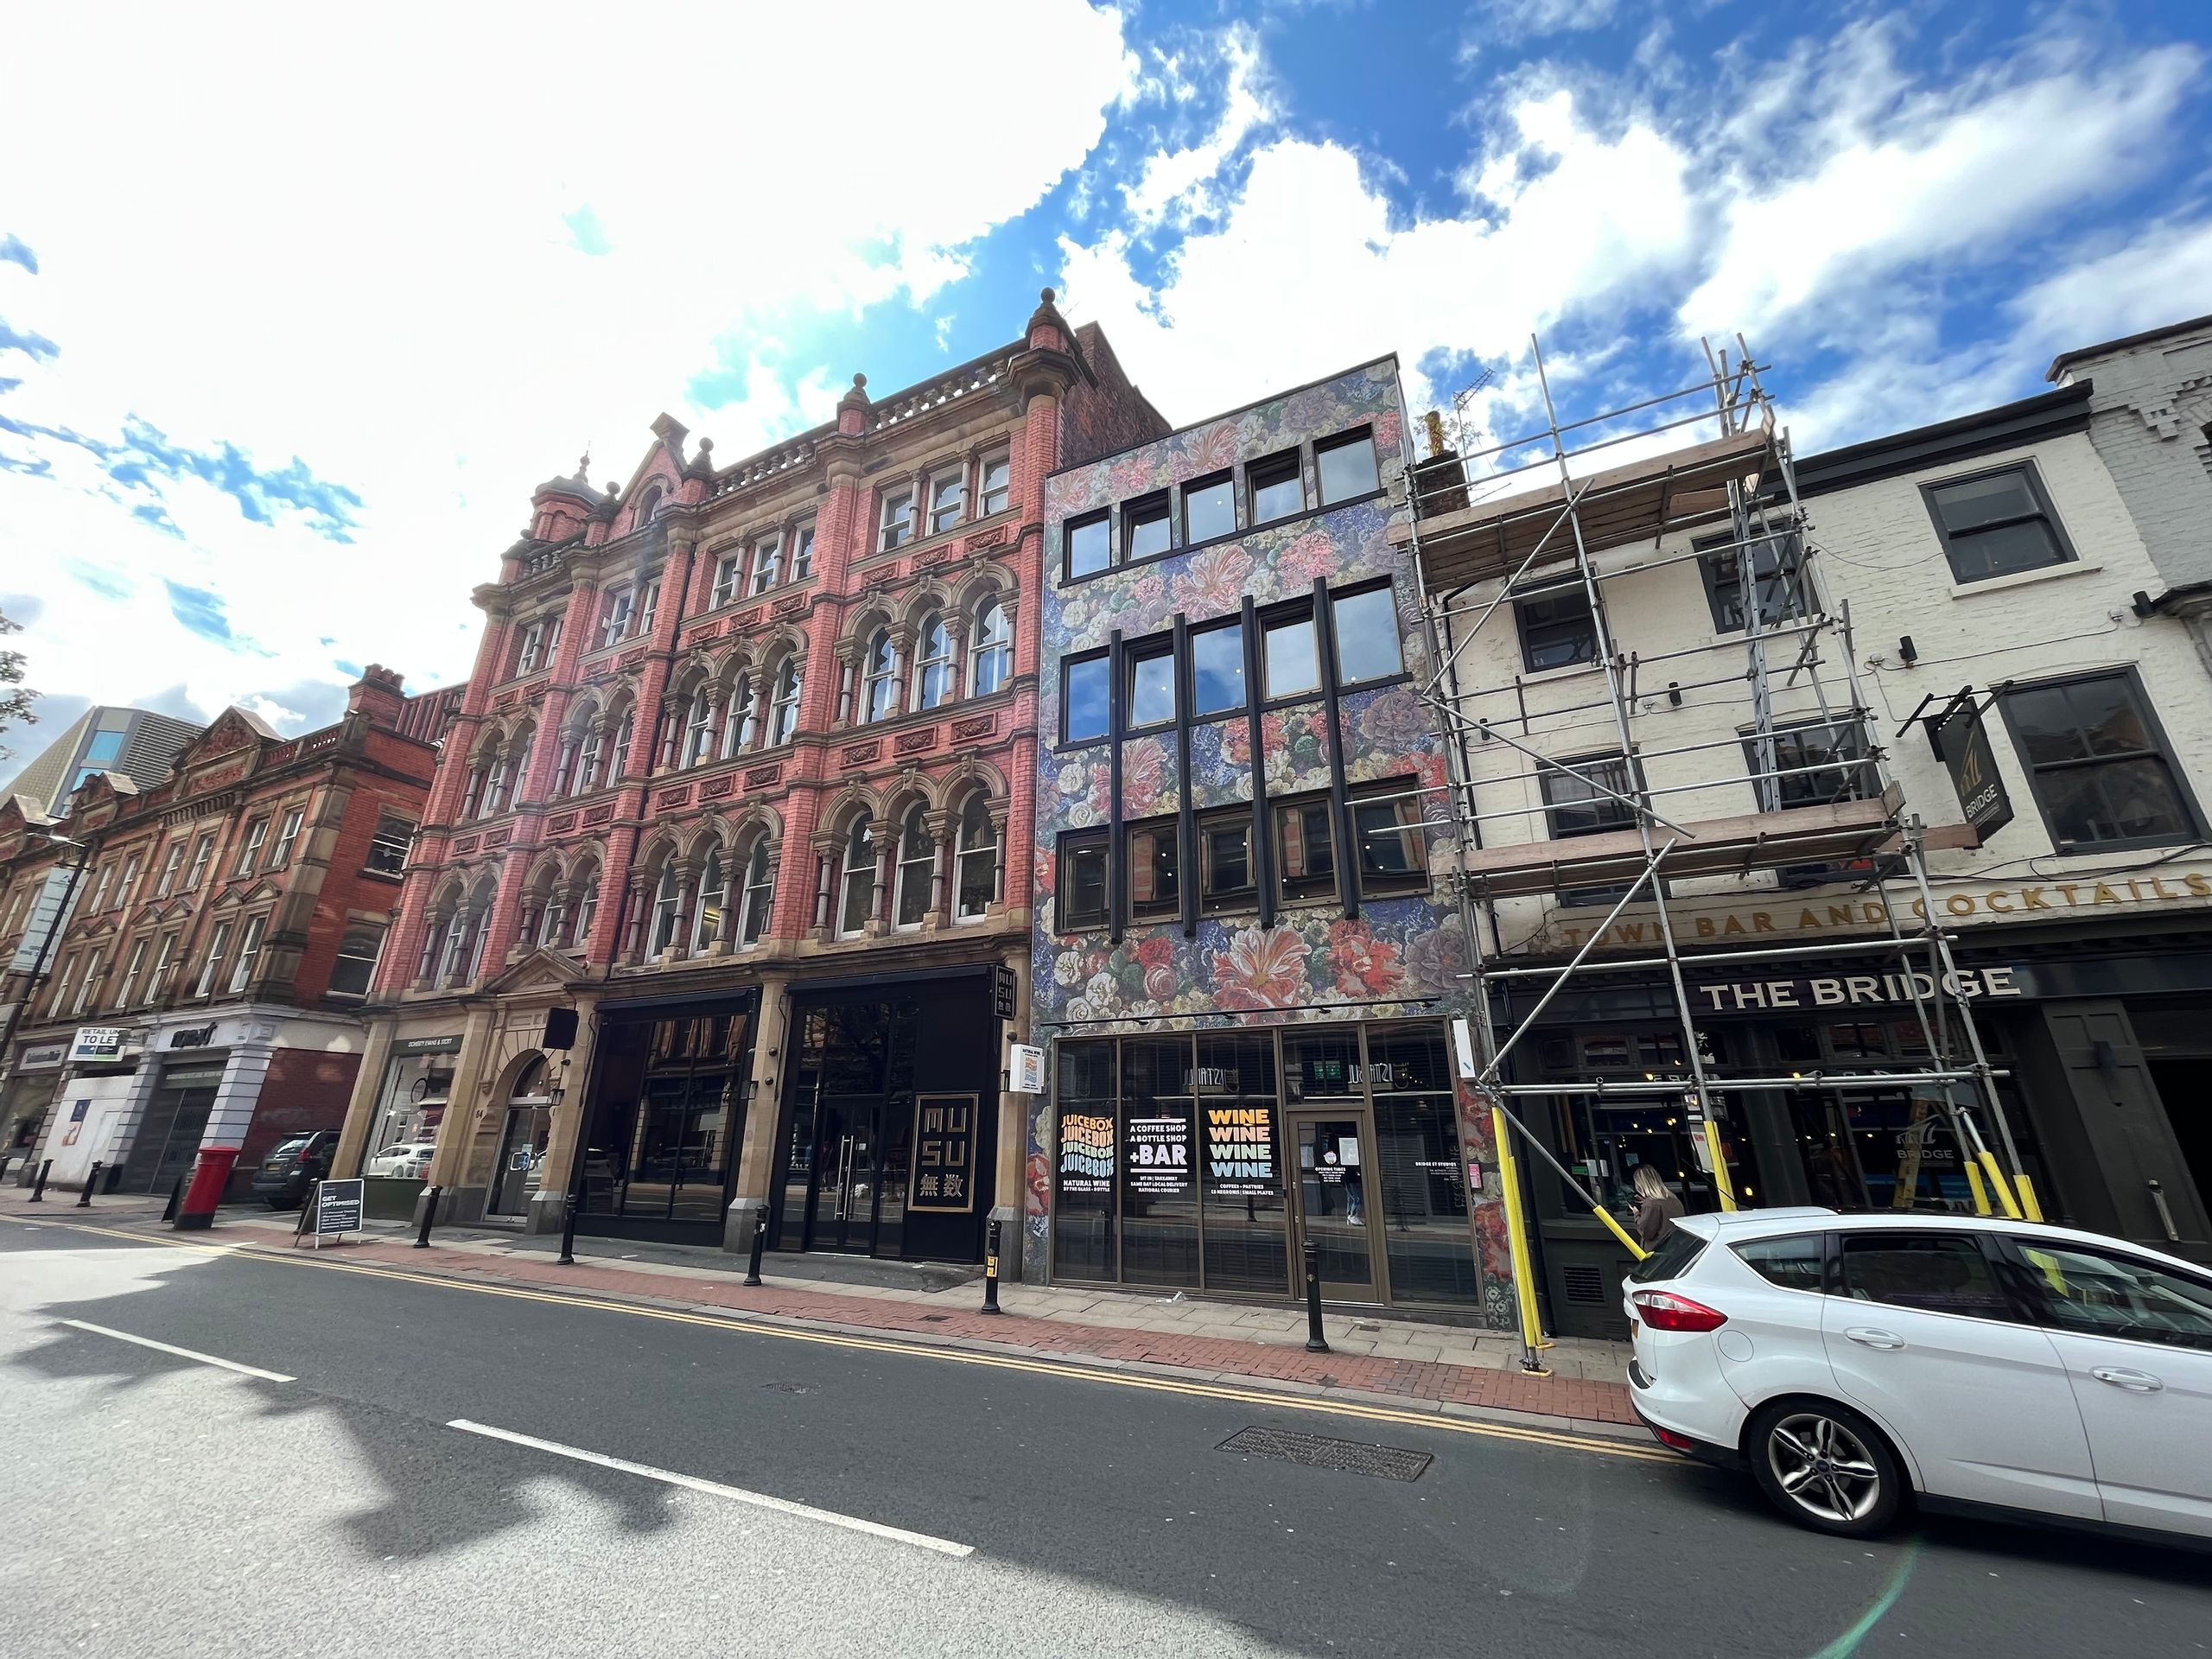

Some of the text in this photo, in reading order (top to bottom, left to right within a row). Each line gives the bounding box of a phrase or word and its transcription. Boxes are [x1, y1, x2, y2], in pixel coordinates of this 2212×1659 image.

[1965, 784, 1998, 819] BRIDGE
[1696, 912, 1777, 938] BAR
[1799, 902, 1887, 929] AND
[1912, 873, 2211, 918] COCKTAILS
[1700, 966, 2021, 1011] THE BRIDGE
[84, 1035, 98, 1044] TO
[924, 1108, 967, 1133] MU
[1061, 1114, 1114, 1131] JUICEBOX
[1208, 1109, 1269, 1125] WINE
[1060, 1125, 1114, 1147] JUICEBOX
[1209, 1127, 1271, 1142] WINE
[921, 1141, 965, 1166] SU
[1060, 1141, 1114, 1159] JUICEBOX
[1210, 1144, 1272, 1160] WINE
[1210, 1162, 1273, 1178] WINE
[919, 1173, 963, 1197] 無数
